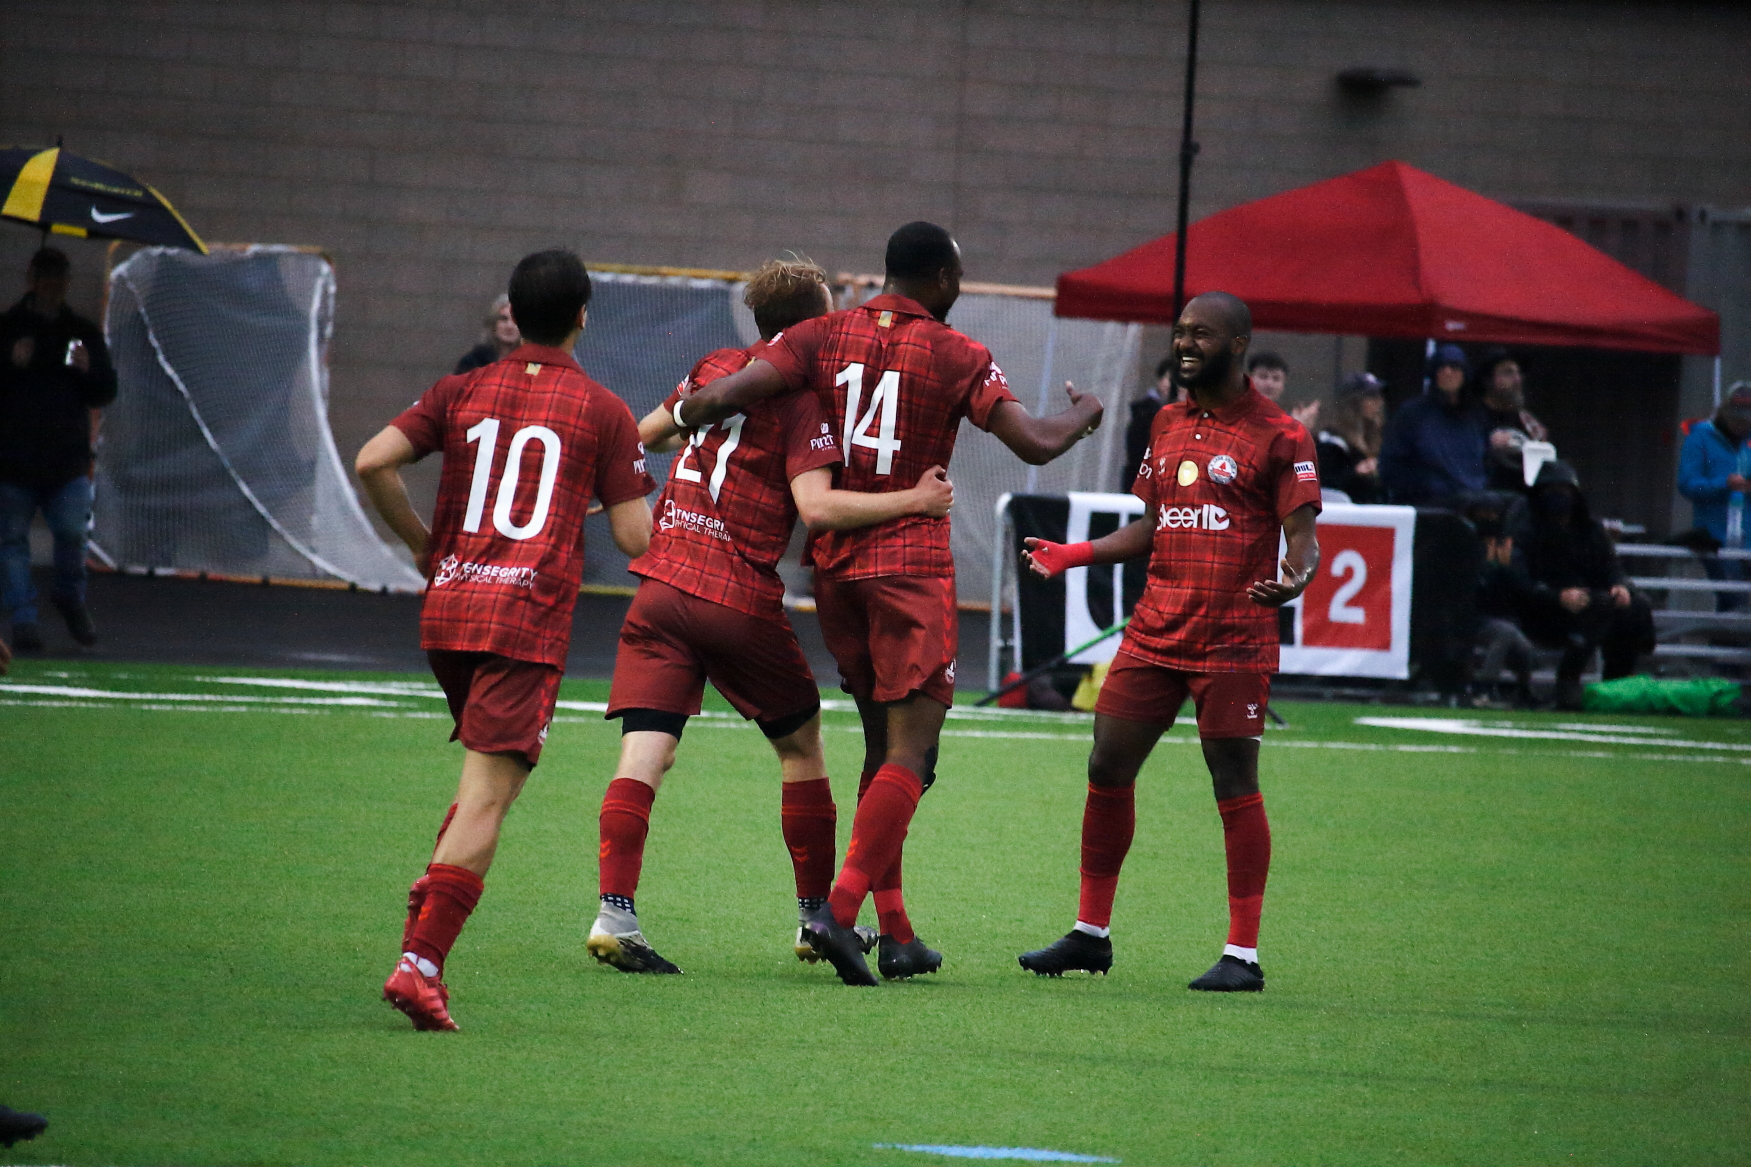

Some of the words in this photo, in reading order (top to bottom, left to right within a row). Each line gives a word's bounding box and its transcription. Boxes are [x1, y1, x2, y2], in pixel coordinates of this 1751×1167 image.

[835, 362, 901, 476] 14
[463, 417, 561, 540] 10
[495, 575, 534, 590] THERAPY
[1328, 548, 1367, 624] 2
